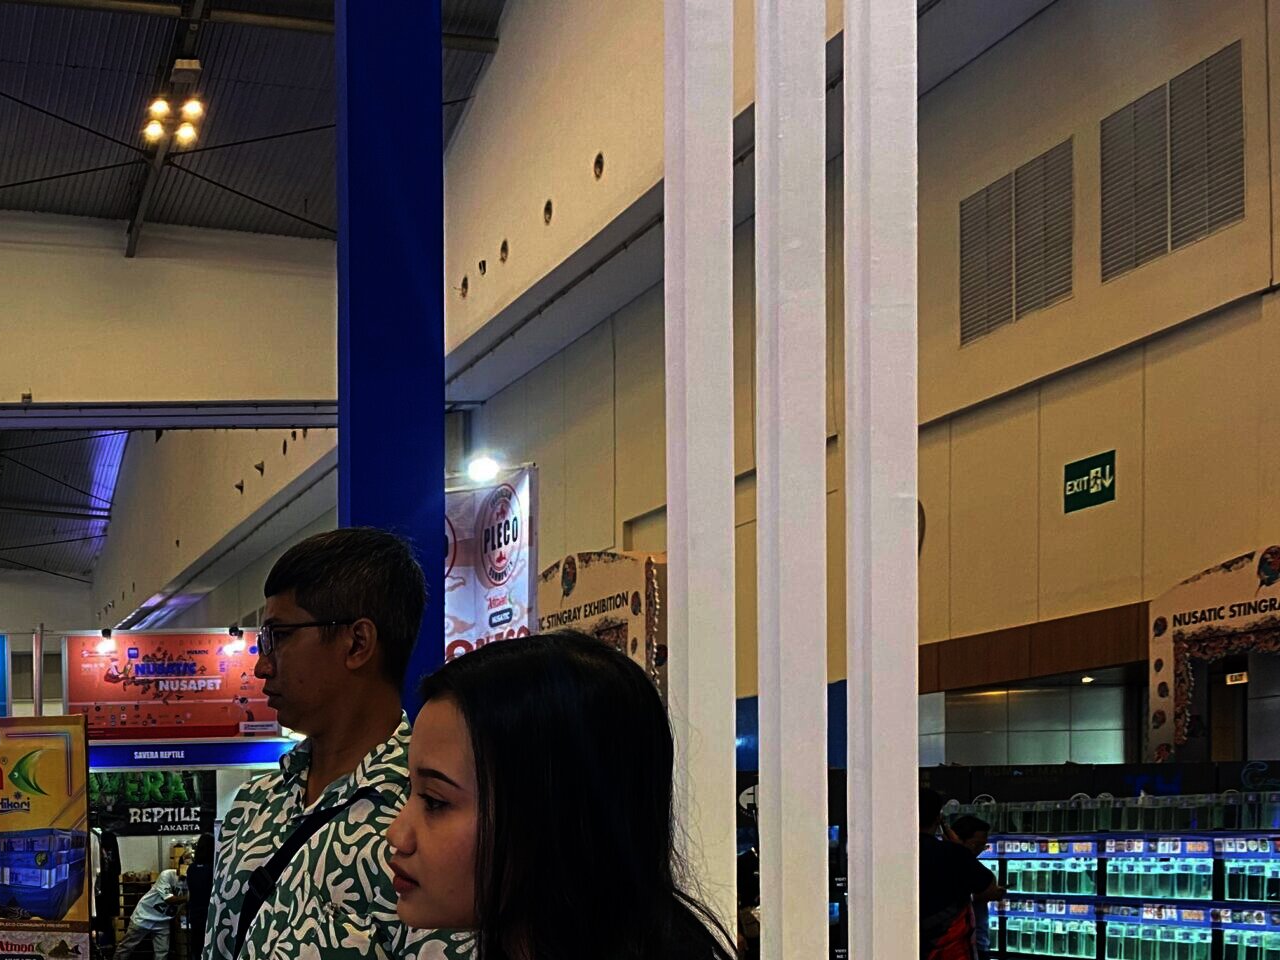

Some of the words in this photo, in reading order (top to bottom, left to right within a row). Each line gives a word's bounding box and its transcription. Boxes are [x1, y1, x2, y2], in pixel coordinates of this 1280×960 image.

[1066, 476, 1089, 495] EXIT
[484, 516, 518, 553] PLECO
[547, 605, 582, 628] STINGRAY
[584, 591, 629, 618] EXHIBITION
[1173, 606, 1225, 627] NUSATIC
[159, 679, 221, 691] NUSAPET
[134, 751, 158, 759] SAVERA
[160, 751, 185, 759] REPTILE
[129, 807, 200, 823] REPTILE
